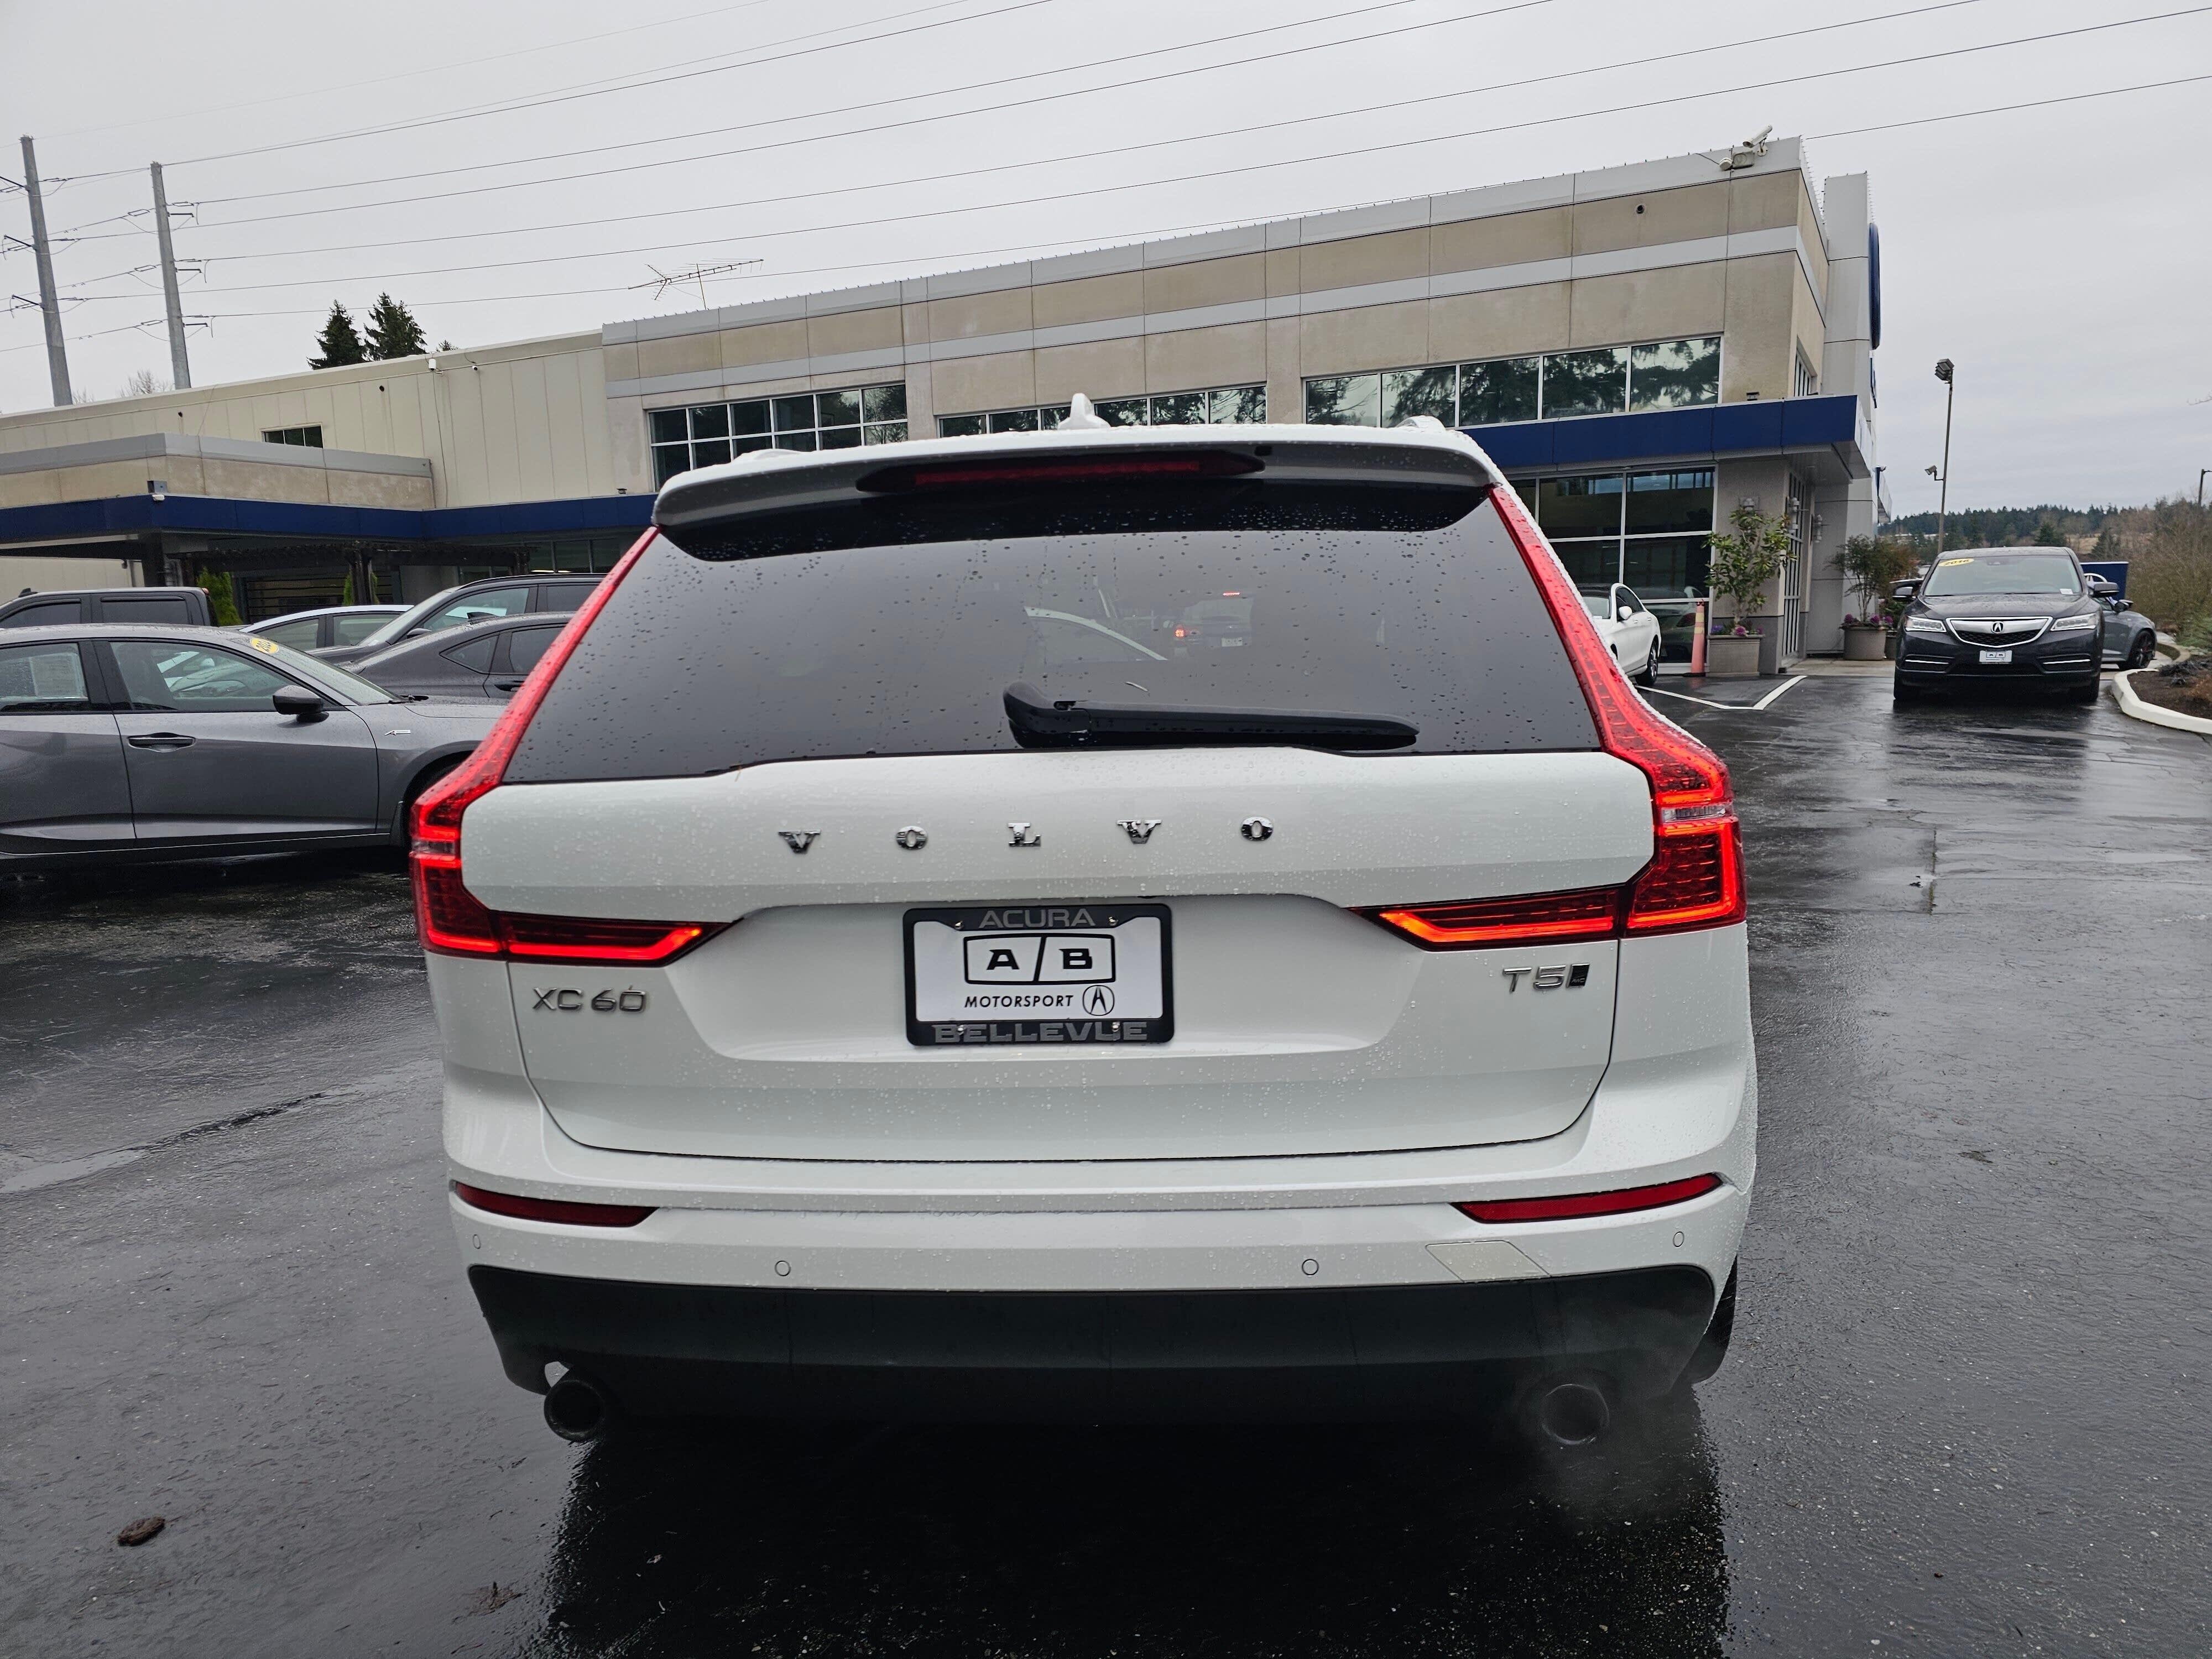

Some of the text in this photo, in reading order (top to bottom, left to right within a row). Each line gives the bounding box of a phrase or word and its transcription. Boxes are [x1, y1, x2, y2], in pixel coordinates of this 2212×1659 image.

[779, 816, 1273, 854] VOLVO
[979, 909, 1095, 928] ACURA
[1503, 965, 1566, 993] T5
[964, 995, 1073, 1008] MOTORSPORT
[933, 1021, 1148, 1043] BELLEVUE
